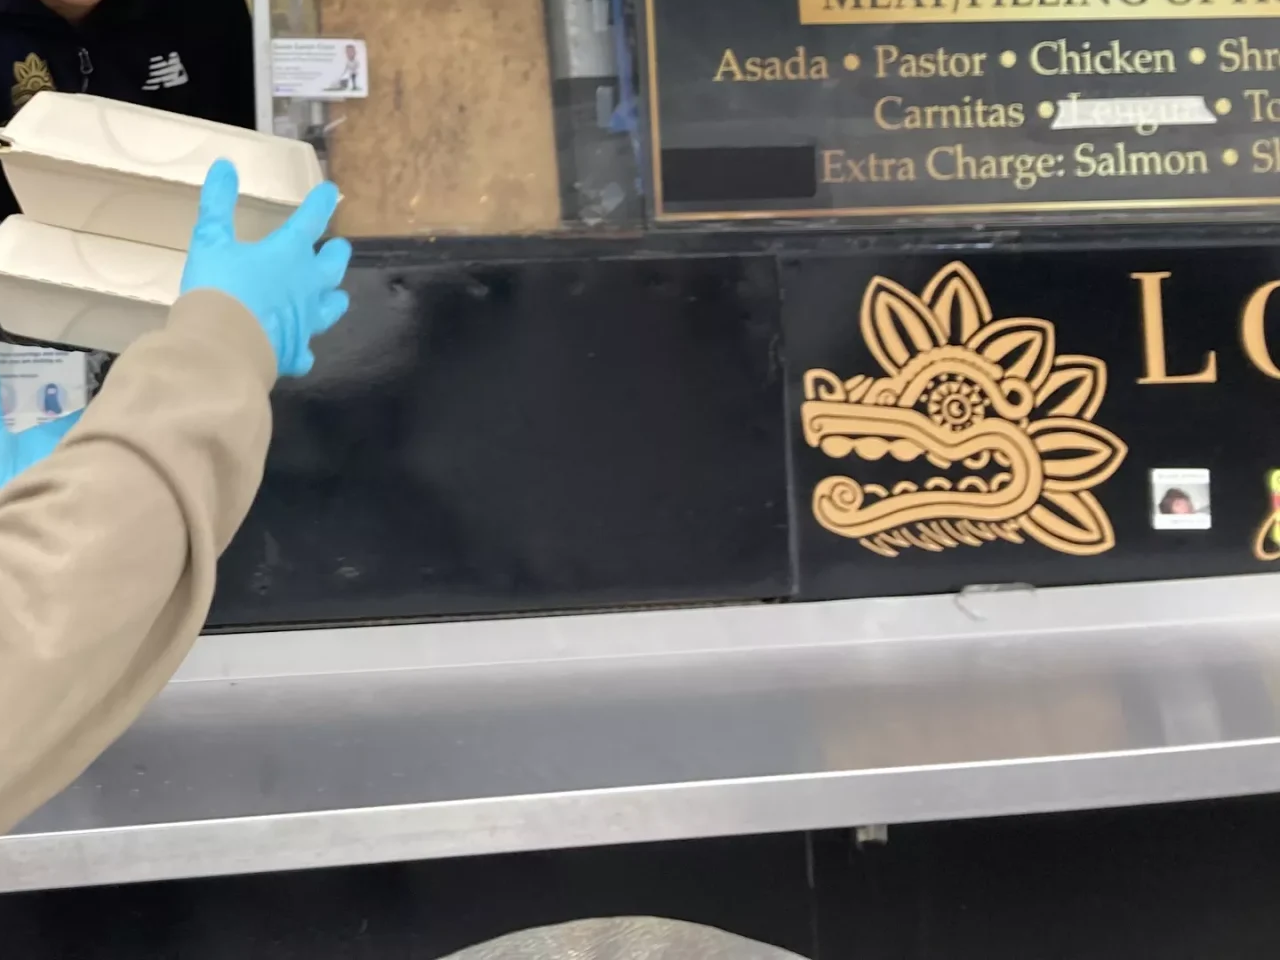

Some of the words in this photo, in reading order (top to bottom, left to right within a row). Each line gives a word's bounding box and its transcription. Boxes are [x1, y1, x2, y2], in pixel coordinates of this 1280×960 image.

[713, 46, 829, 83] Asada
[874, 44, 987, 79] Pastor
[1029, 39, 1177, 77] Chicken
[1219, 36, 1280, 73] Shr
[874, 95, 1025, 132] Carnitas
[821, 149, 916, 185] Extra
[926, 146, 1066, 192] Charge:
[1074, 143, 1209, 179] Salmon
